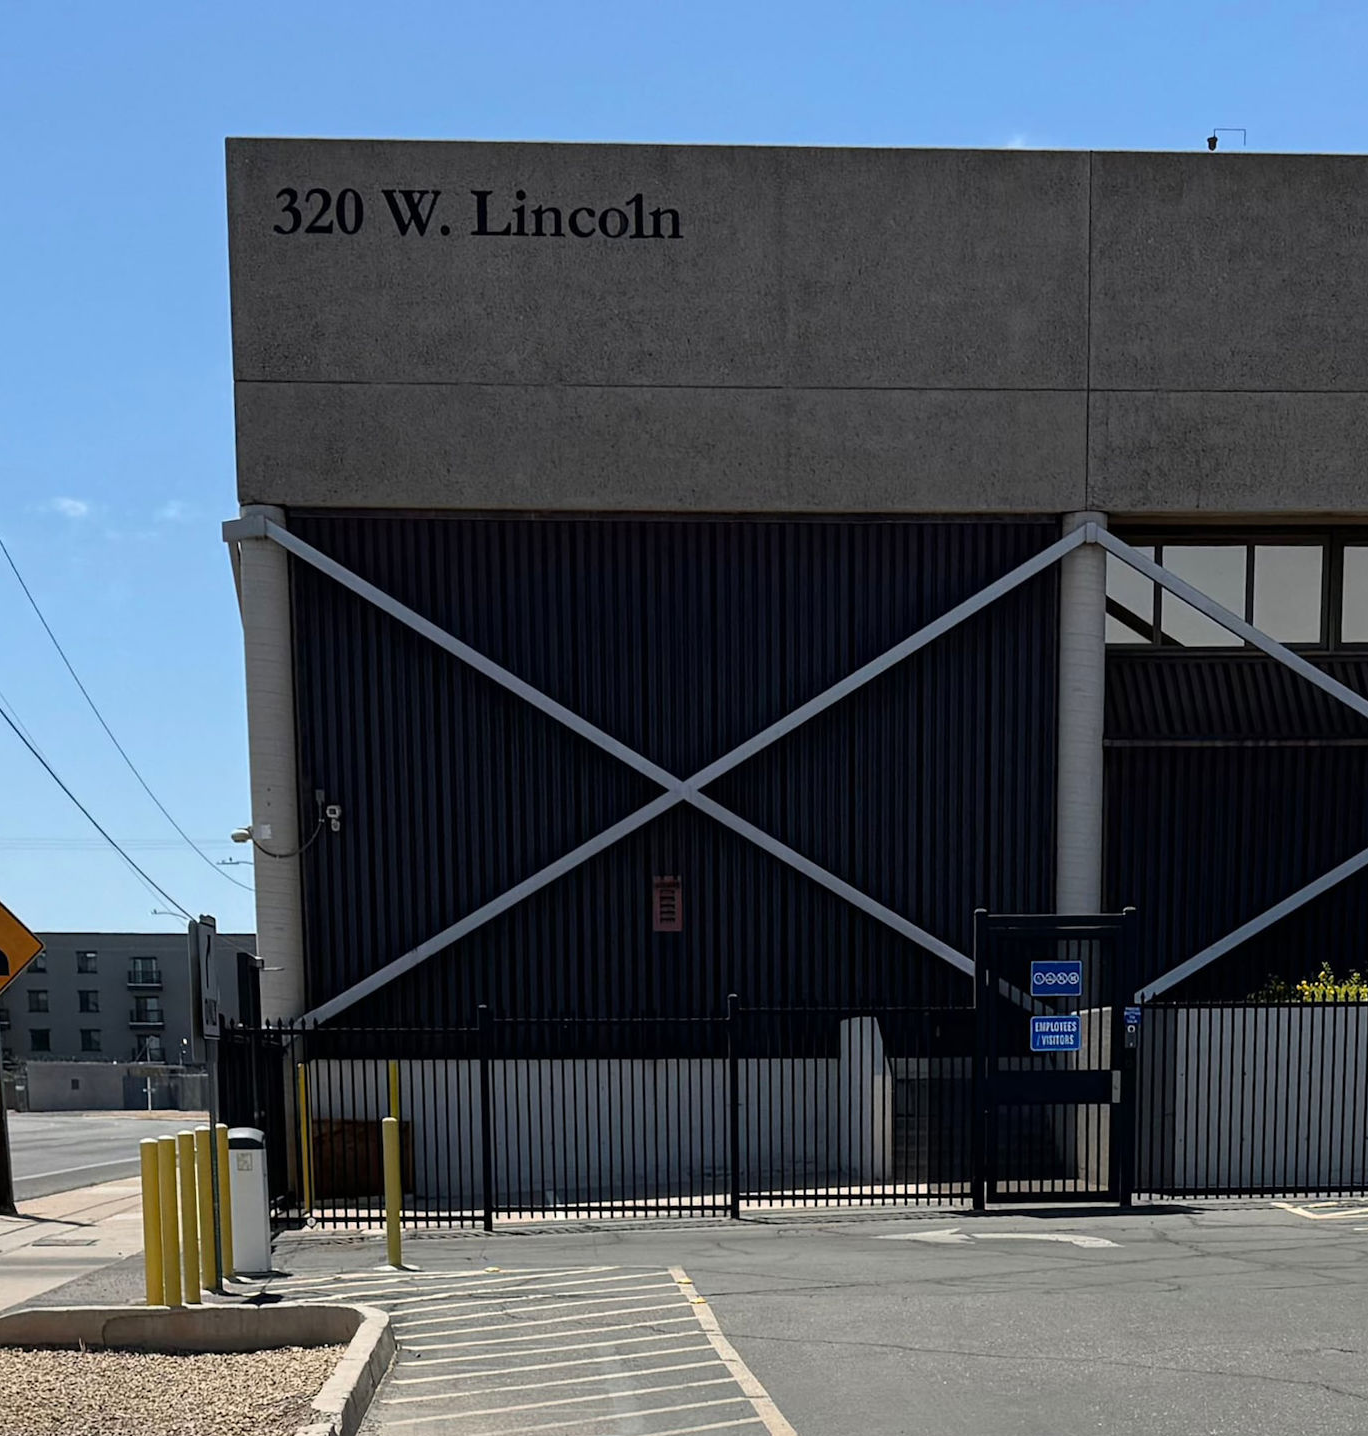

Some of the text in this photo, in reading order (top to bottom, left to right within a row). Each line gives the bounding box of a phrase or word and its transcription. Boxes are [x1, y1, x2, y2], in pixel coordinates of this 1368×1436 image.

[273, 187, 684, 239] 320 W. Lincoln
[1035, 1021, 1077, 1033] EMPLOYEES
